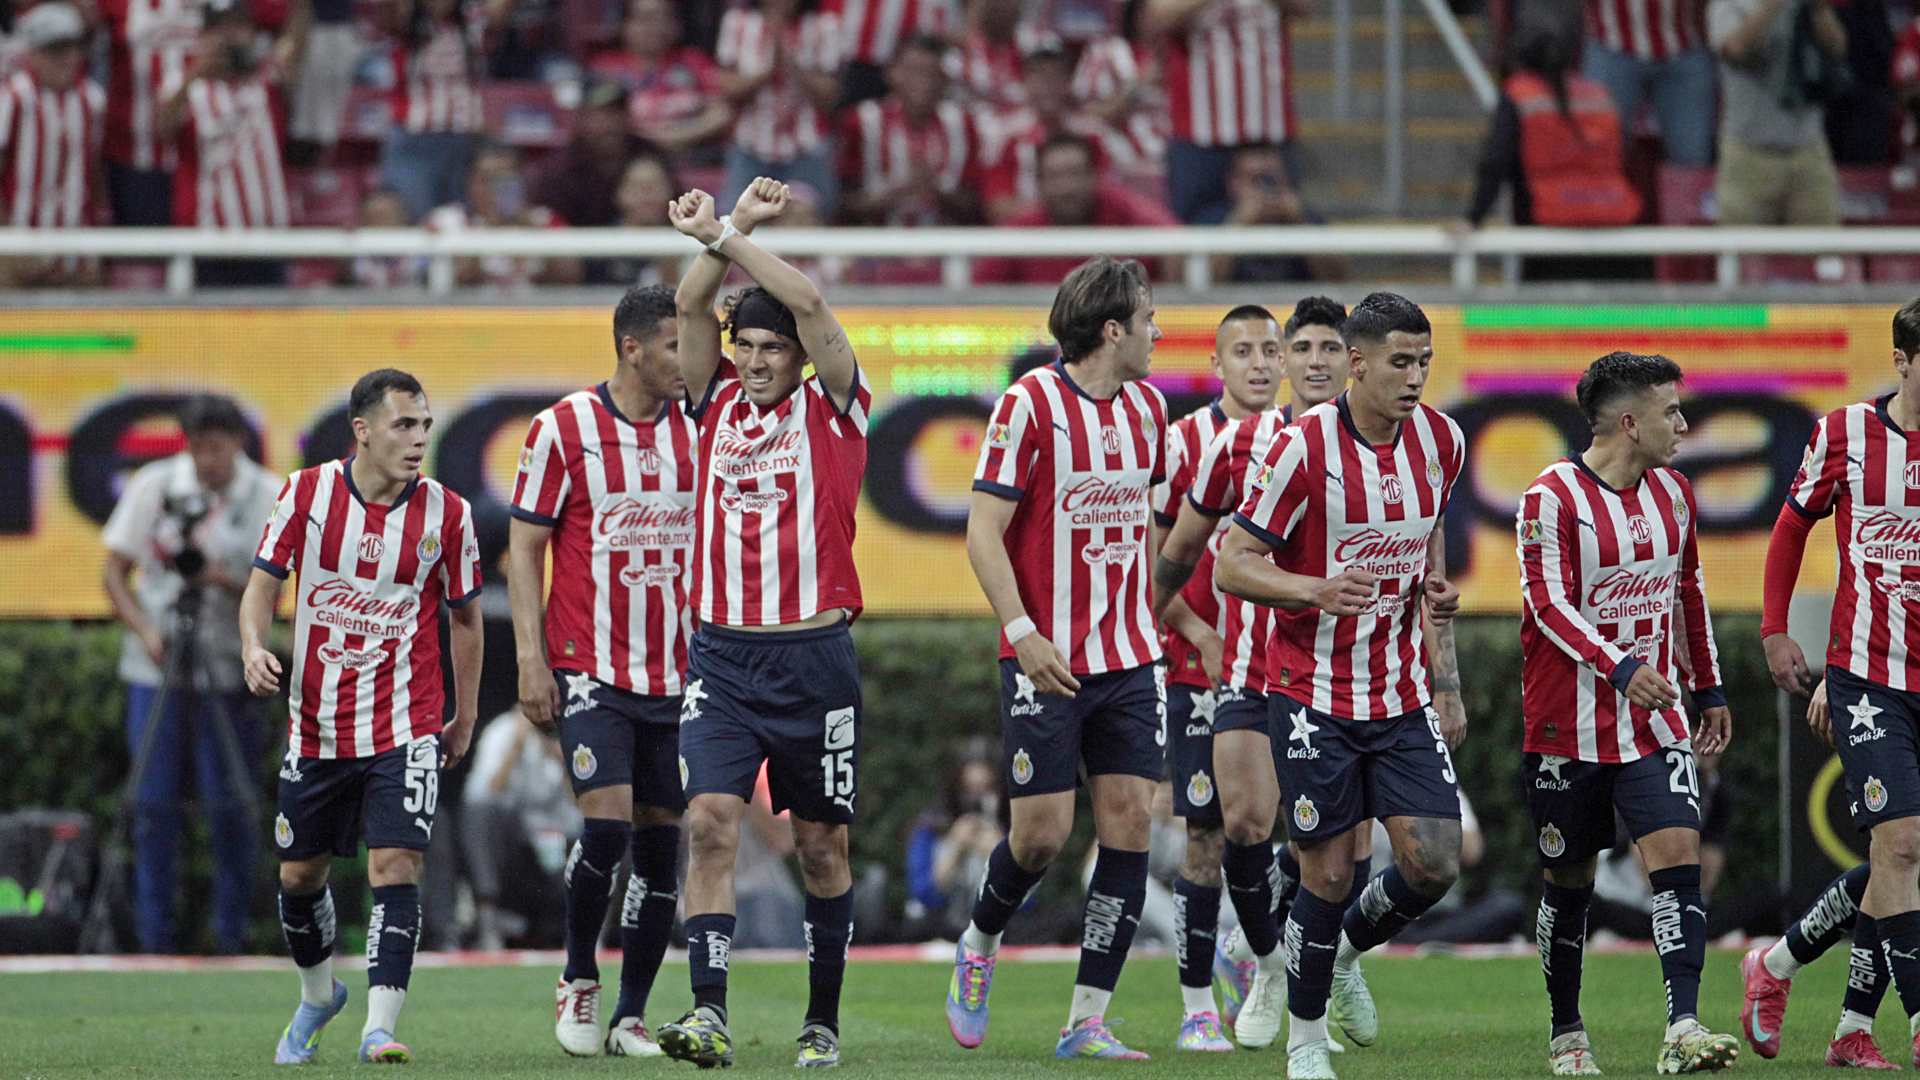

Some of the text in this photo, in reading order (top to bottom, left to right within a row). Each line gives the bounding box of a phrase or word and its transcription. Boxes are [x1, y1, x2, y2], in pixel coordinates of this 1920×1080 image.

[1102, 428, 1120, 452] MG
[714, 455, 800, 477] cliente.mx
[1379, 476, 1403, 503] MG
[599, 497, 697, 536] Caliente
[1629, 517, 1651, 541] MG
[358, 535, 385, 562] MG
[609, 531, 691, 547] caliente.mx
[1334, 527, 1430, 563] Calient
[306, 578, 415, 621] Caliente
[1598, 598, 1672, 620] caliente.
[315, 609, 408, 637] caliente.mx
[403, 768, 438, 815] 58
[821, 750, 854, 797] 15
[1665, 750, 1700, 798] 20
[1082, 890, 1125, 954] PERDURA
[1650, 889, 1687, 956] PERDURA
[1800, 878, 1859, 945] PERDURA
